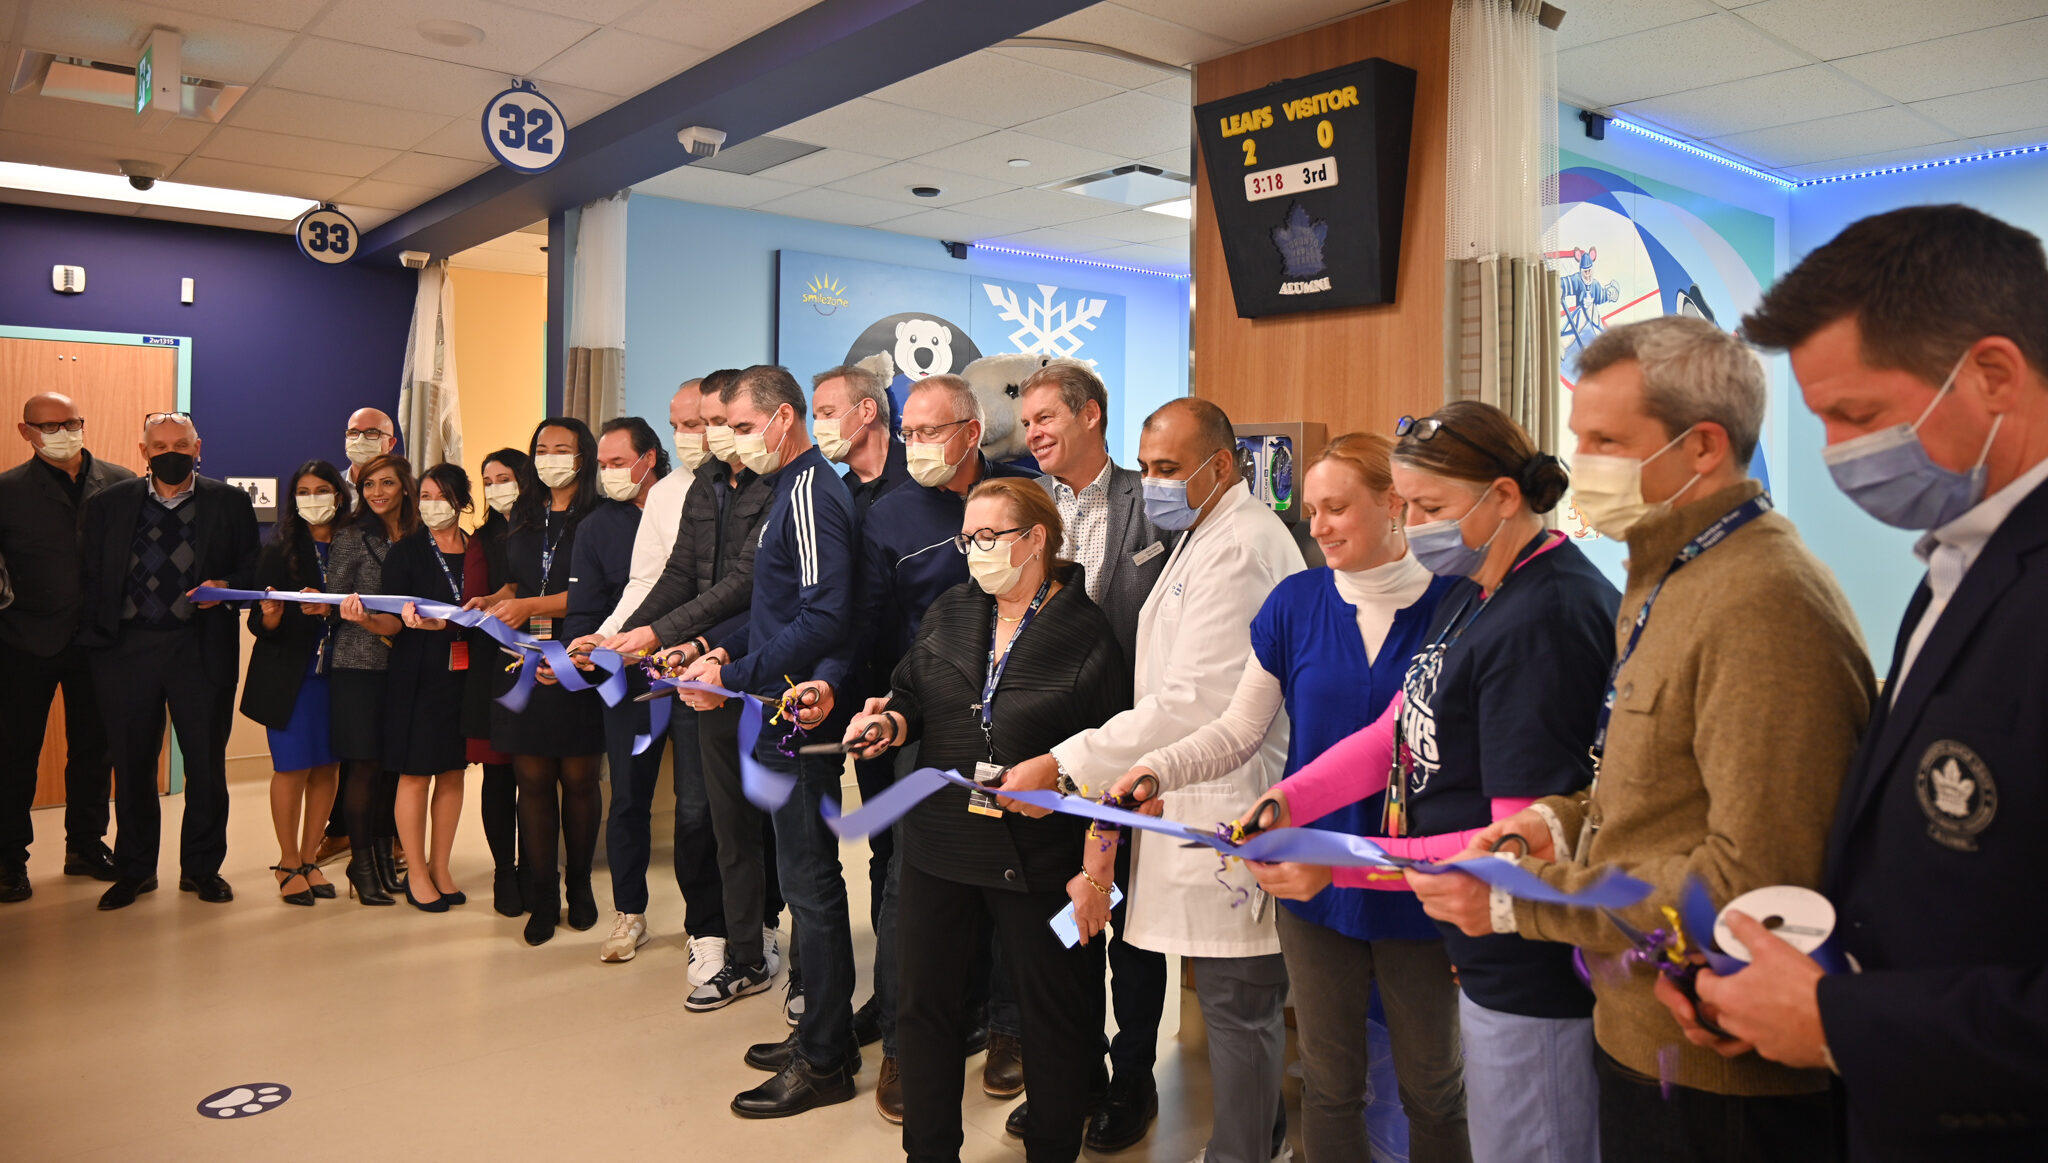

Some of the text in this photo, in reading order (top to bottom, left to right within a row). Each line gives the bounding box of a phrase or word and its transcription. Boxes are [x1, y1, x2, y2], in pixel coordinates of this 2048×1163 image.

[1220, 85, 1360, 138] LEAFS VISITOR
[499, 103, 553, 154] 32
[1242, 119, 1334, 166] 2 0
[1253, 163, 1327, 194] 3:18 3rd
[309, 221, 349, 254] 33
[802, 293, 849, 307] smilezone
[1279, 277, 1332, 295] ALUMNI
